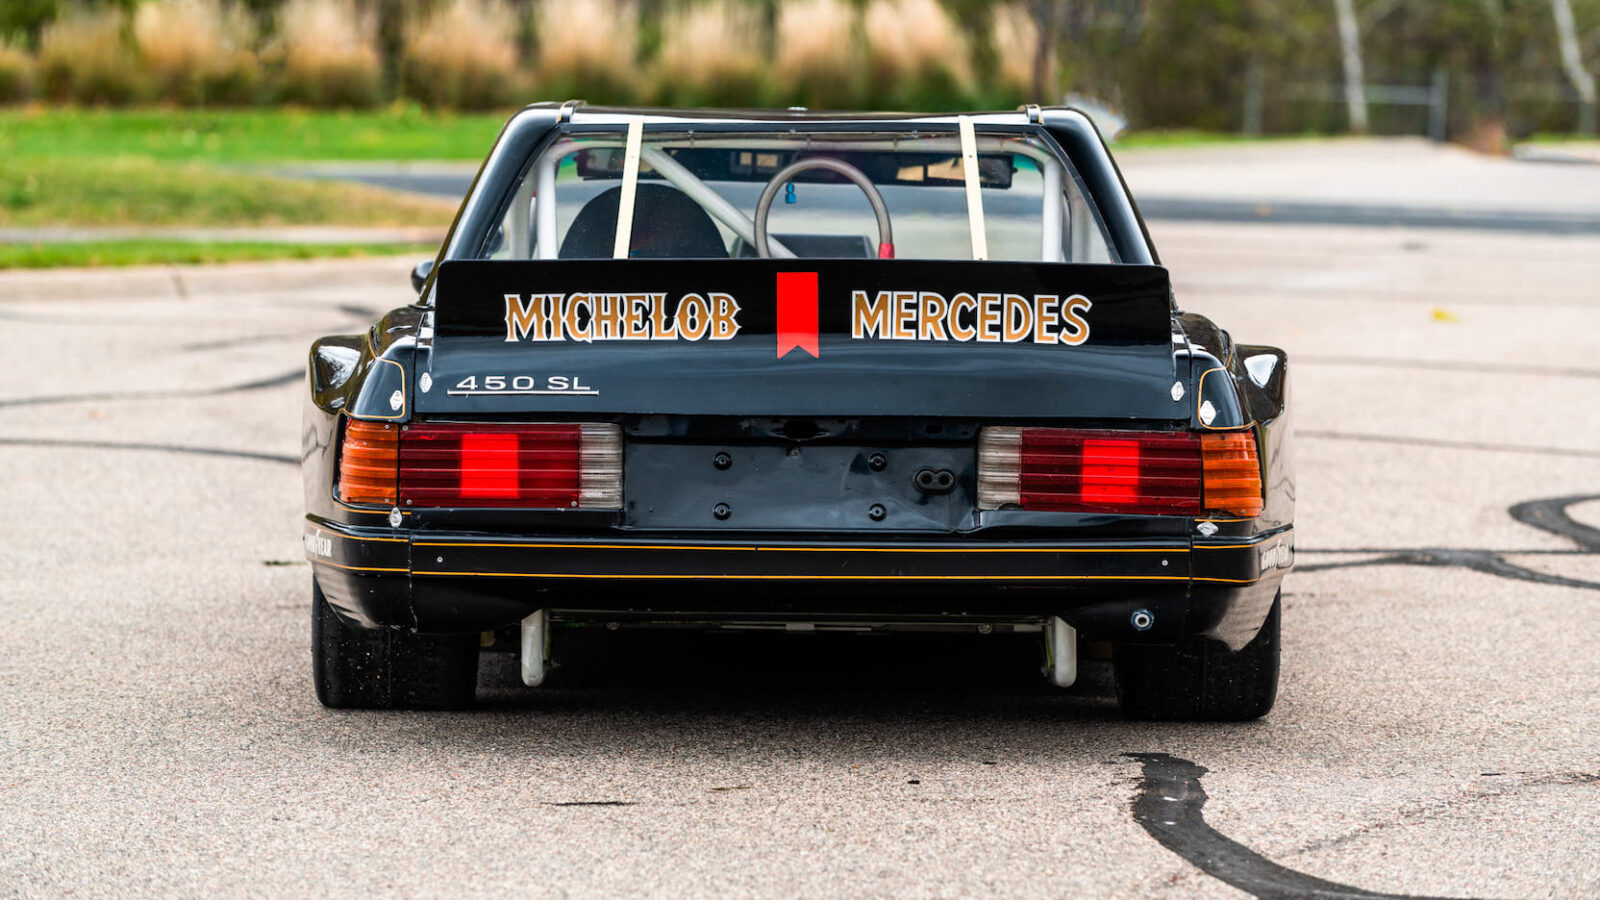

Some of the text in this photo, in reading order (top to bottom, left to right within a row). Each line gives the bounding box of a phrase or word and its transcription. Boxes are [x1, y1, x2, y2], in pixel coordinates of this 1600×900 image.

[504, 290, 1093, 346] MICHELOB MERCEDES
[456, 375, 591, 391] 450 SL
